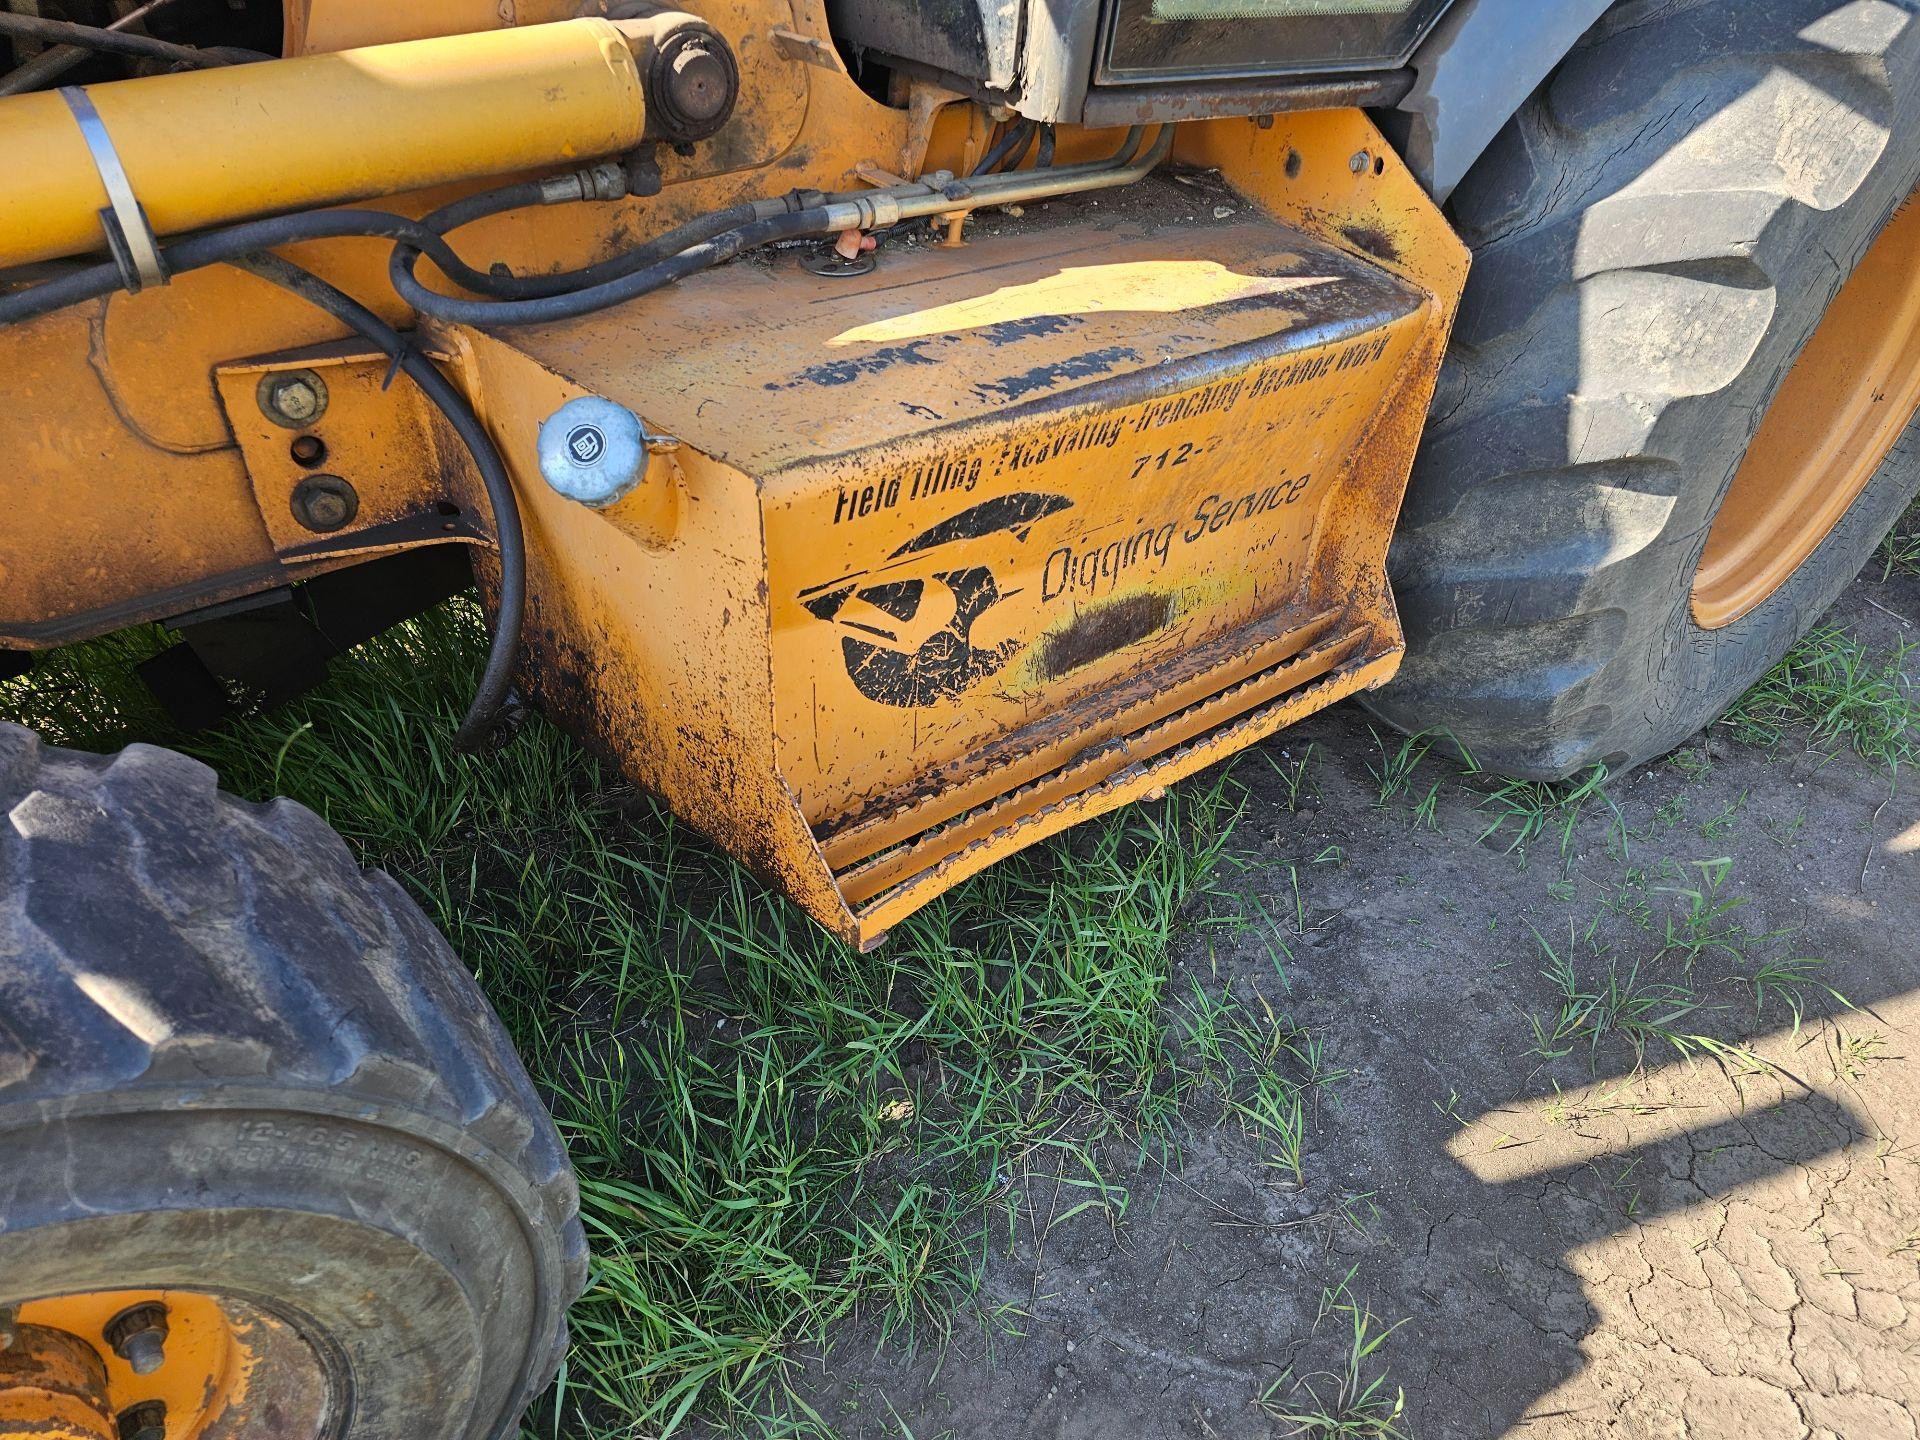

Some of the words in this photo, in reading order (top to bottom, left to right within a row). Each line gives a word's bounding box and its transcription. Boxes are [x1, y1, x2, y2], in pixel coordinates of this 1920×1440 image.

[1334, 332, 1392, 372] Work
[1041, 517, 1178, 604] Digging
[1184, 468, 1311, 544] Service
